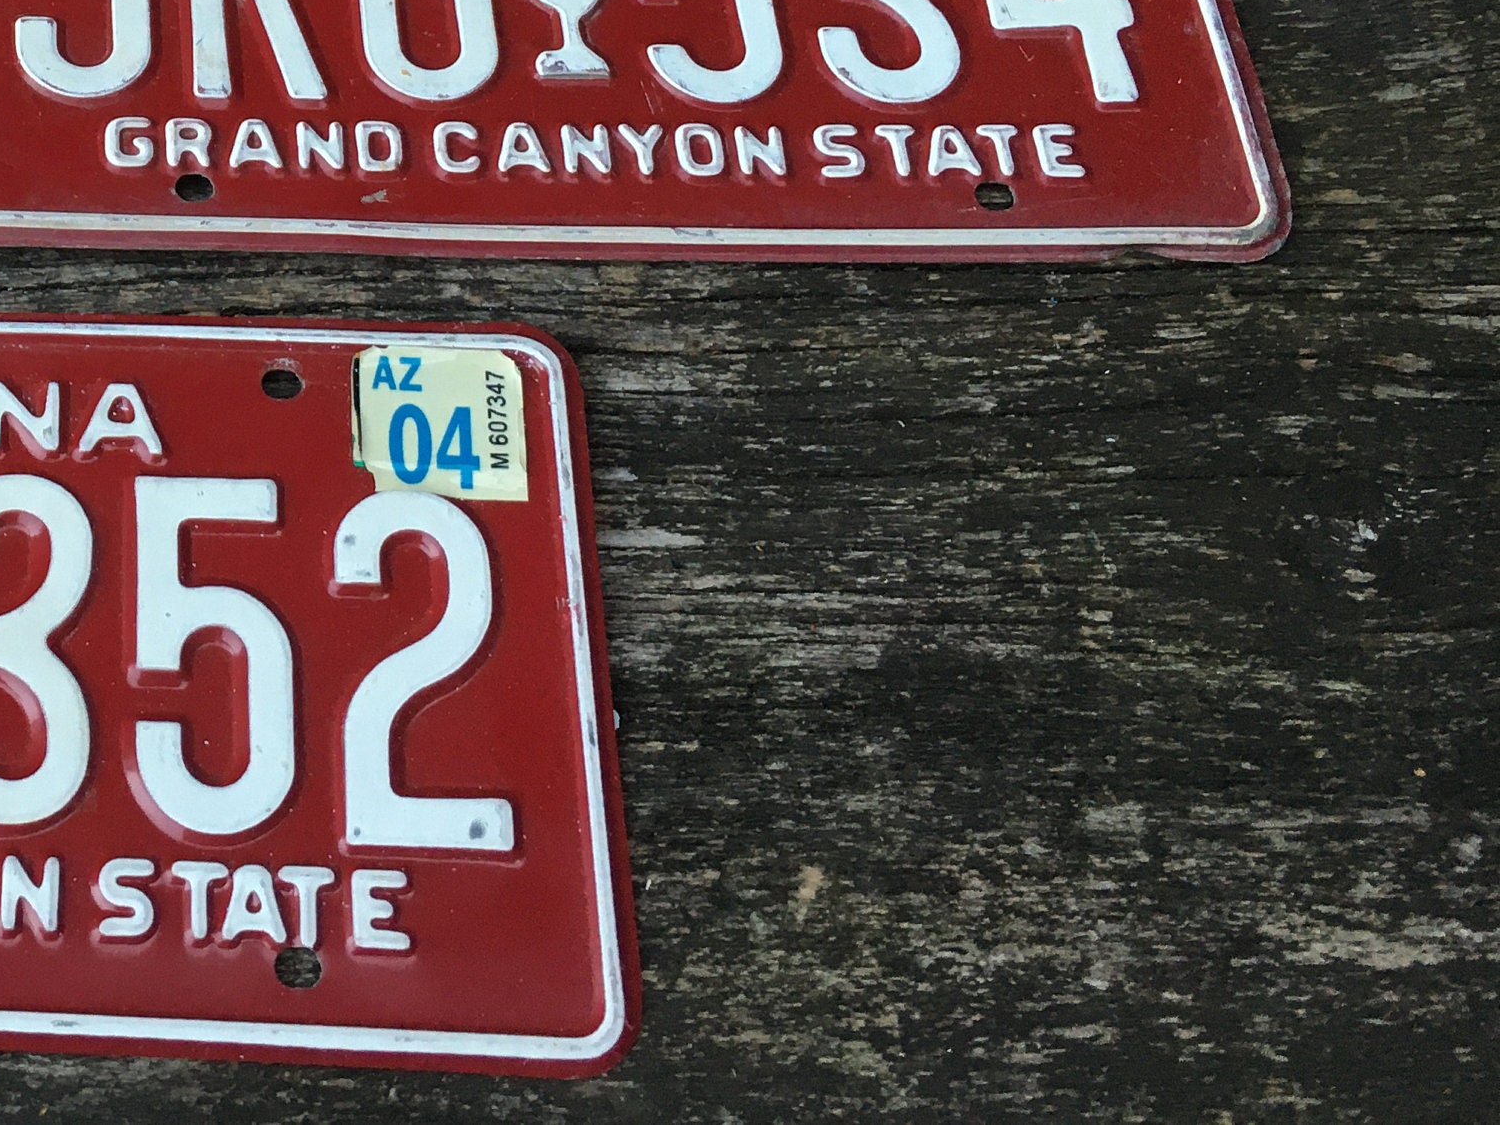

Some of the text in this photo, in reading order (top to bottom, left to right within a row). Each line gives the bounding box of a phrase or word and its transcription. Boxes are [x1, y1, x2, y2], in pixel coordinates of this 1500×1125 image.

[103, 116, 1086, 178] GRAND CANYON STATE
[372, 355, 422, 392] AZ
[485, 370, 509, 446] 607347
[388, 403, 480, 490] 04
[98, 857, 410, 951] STATE
